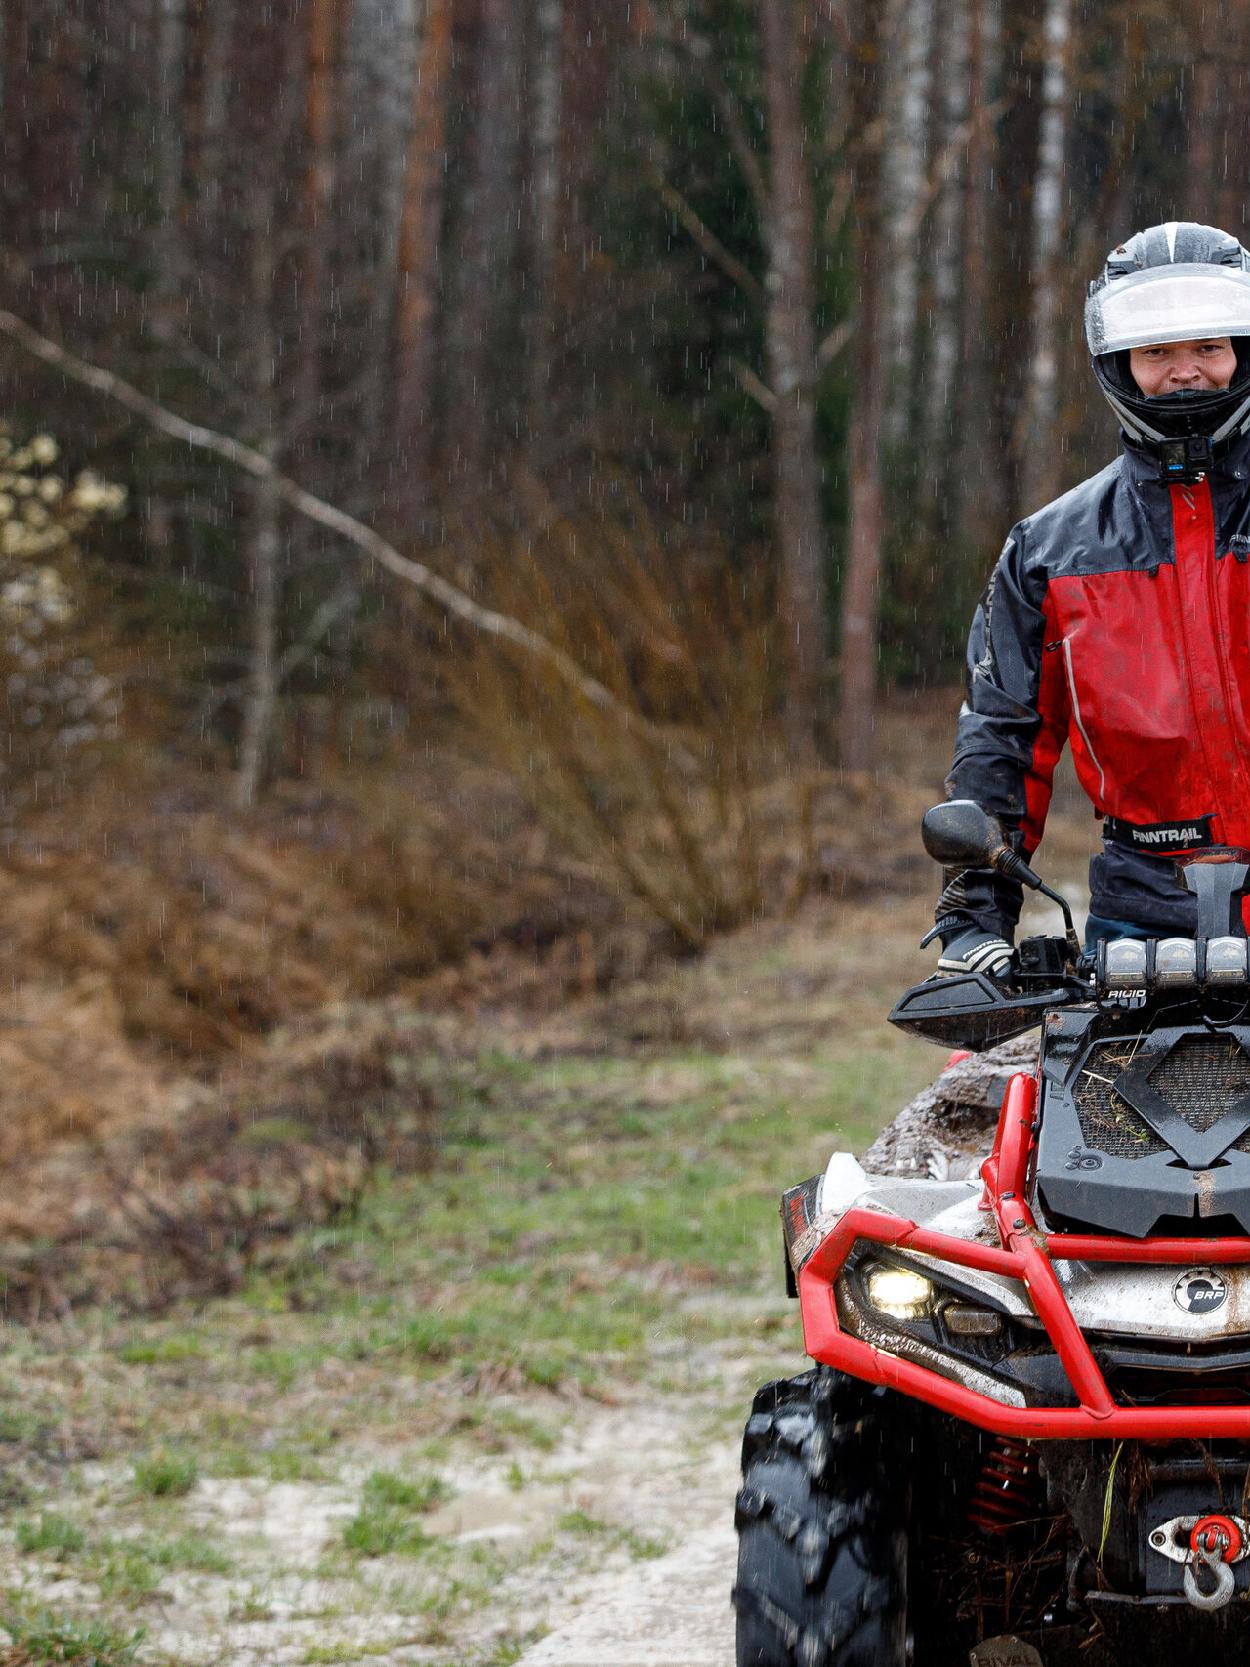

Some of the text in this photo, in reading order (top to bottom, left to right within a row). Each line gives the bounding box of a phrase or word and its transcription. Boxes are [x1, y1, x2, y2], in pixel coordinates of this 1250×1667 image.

[1132, 828, 1202, 843] FINNTRAIL
[1108, 990, 1146, 998] RIGID
[1194, 1291, 1224, 1300] BRP
